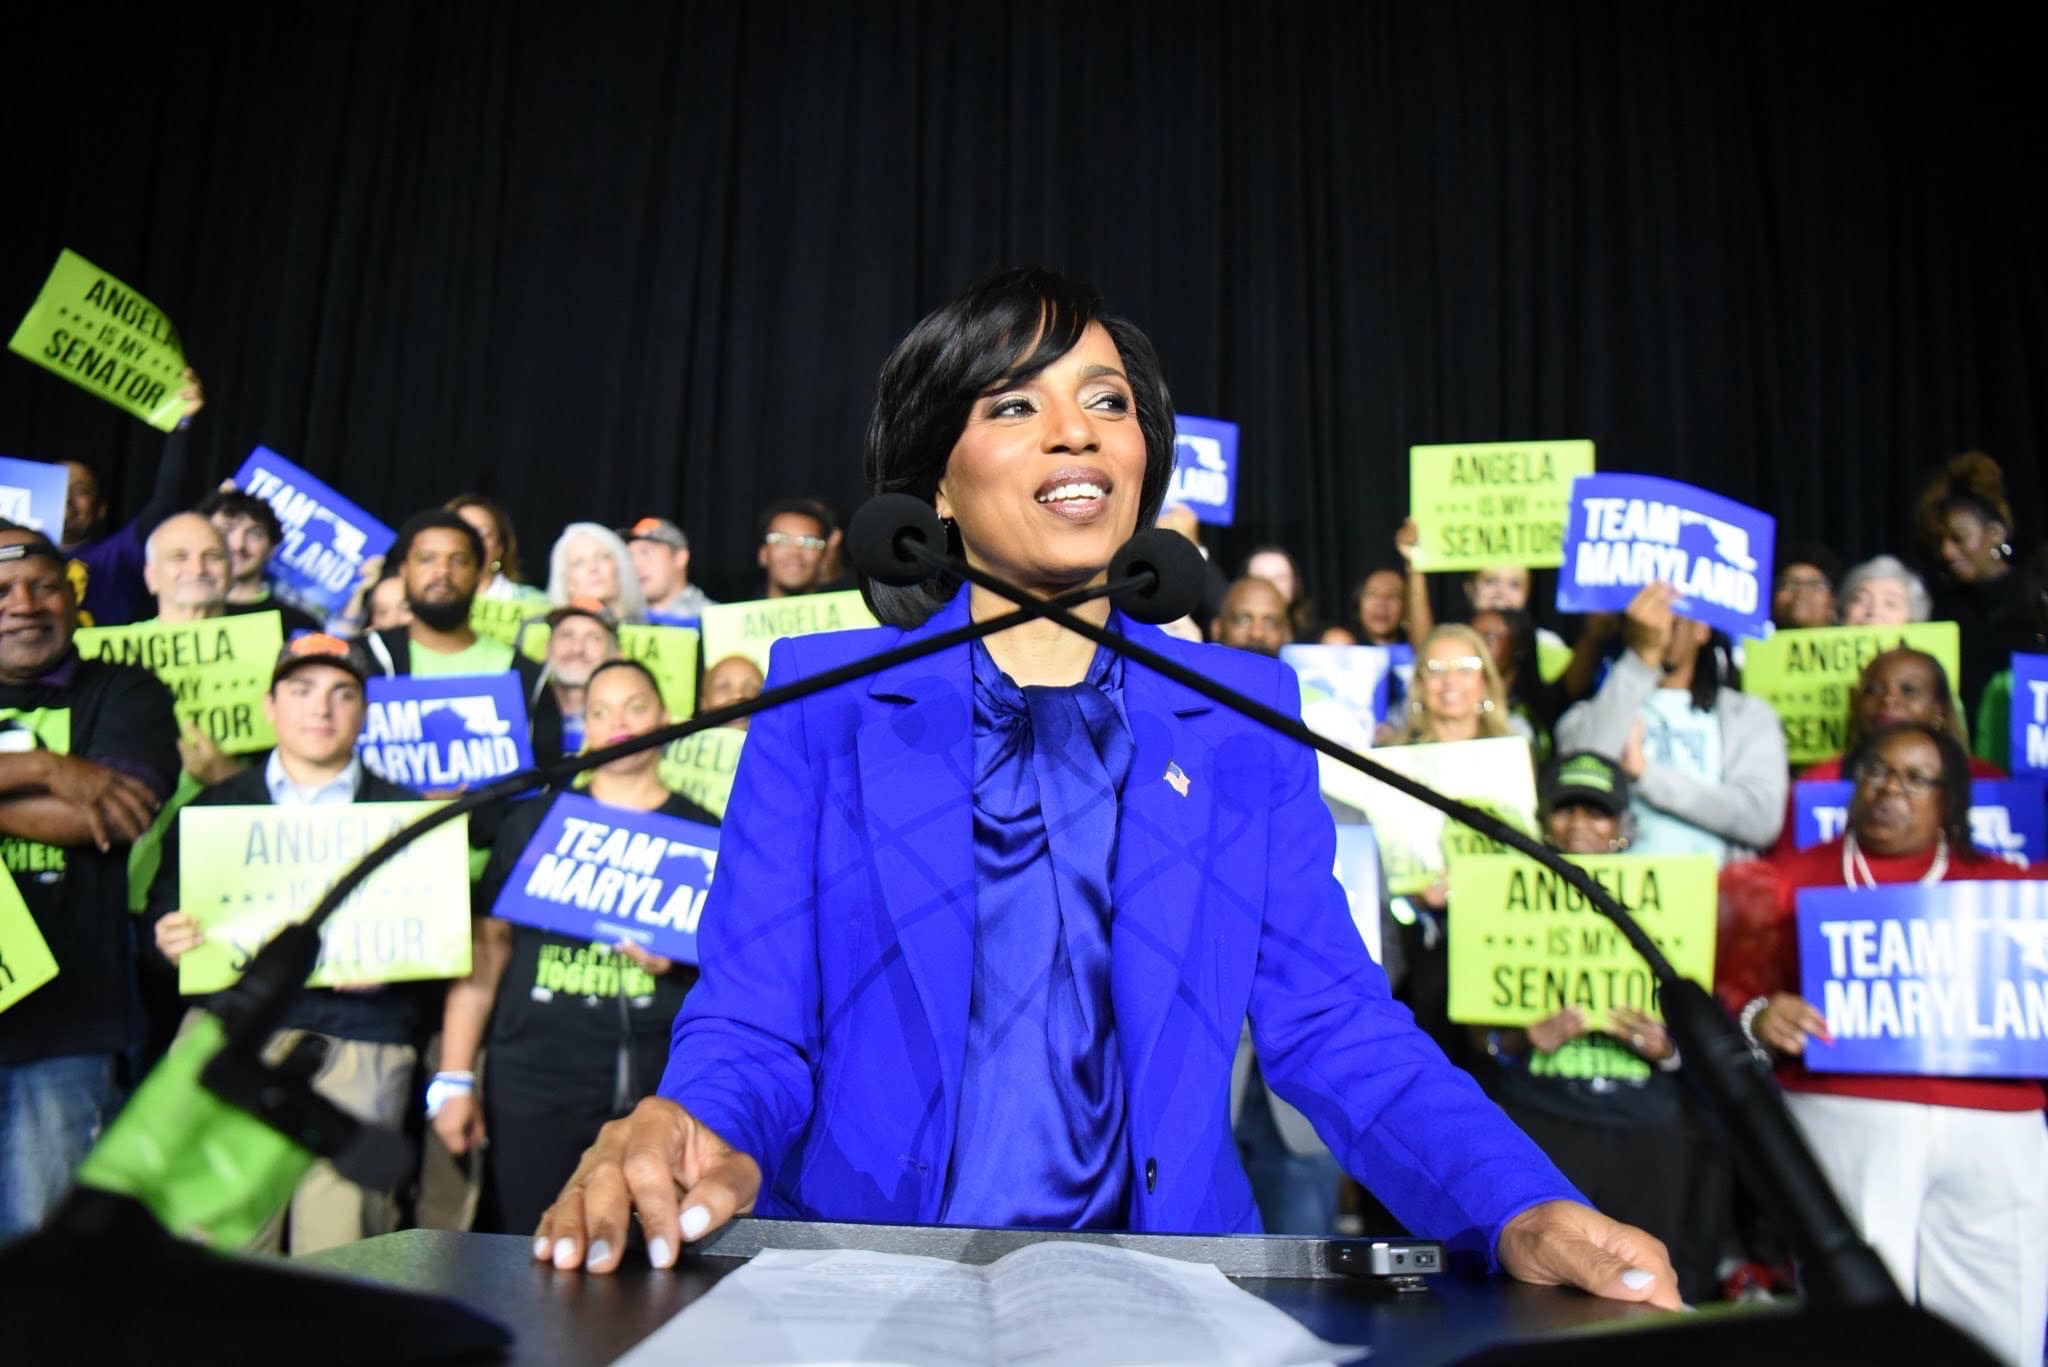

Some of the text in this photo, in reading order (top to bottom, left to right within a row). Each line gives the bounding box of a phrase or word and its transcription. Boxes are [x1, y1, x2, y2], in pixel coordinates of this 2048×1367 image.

[84, 278, 179, 351] ANGELA
[96, 322, 147, 361] IS MY
[44, 328, 166, 410] SENATOR
[1450, 451, 1555, 486] ANGELA
[244, 466, 319, 530] TEAM
[1477, 495, 1527, 516] IS MY
[1582, 497, 1682, 546] TEAM
[1574, 541, 1759, 615] MARYLAND
[741, 603, 842, 640] ANGELA
[99, 628, 236, 669] ANGELA
[361, 735, 520, 786] ARYLAND
[554, 816, 670, 875] TEAM
[1547, 927, 1619, 956] IS MY
[1819, 917, 1953, 979] TEAM
[1823, 978, 2048, 1041] MARYLAN
